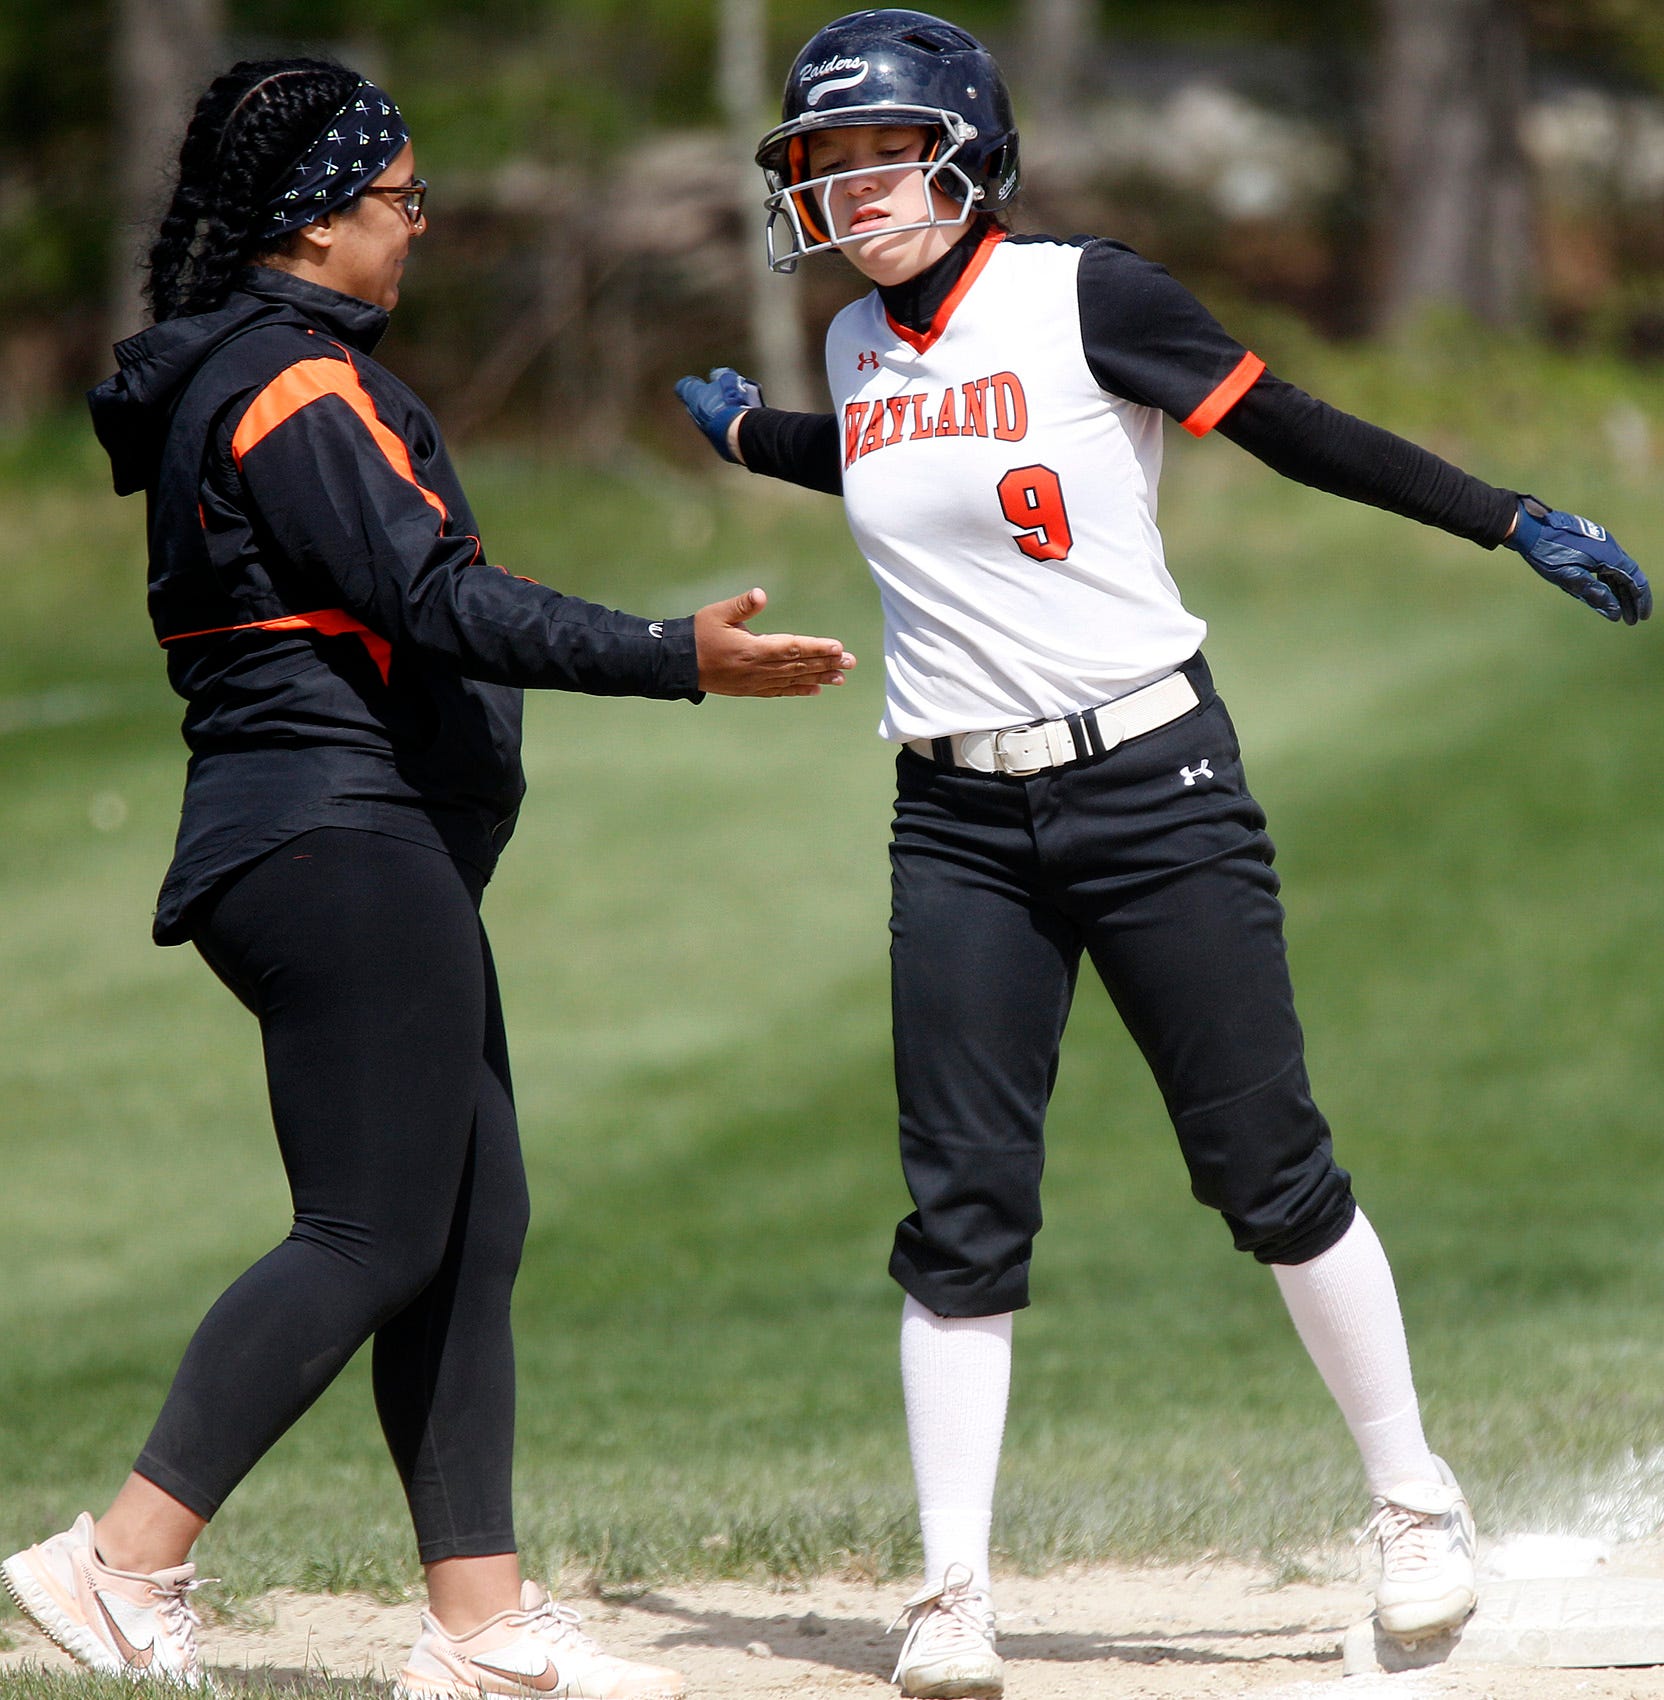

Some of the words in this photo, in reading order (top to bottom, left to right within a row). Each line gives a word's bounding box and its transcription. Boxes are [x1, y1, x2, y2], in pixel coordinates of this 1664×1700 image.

[799, 54, 861, 87] Raiders
[845, 371, 1028, 471] WAYLAND
[996, 463, 1074, 562] 9
